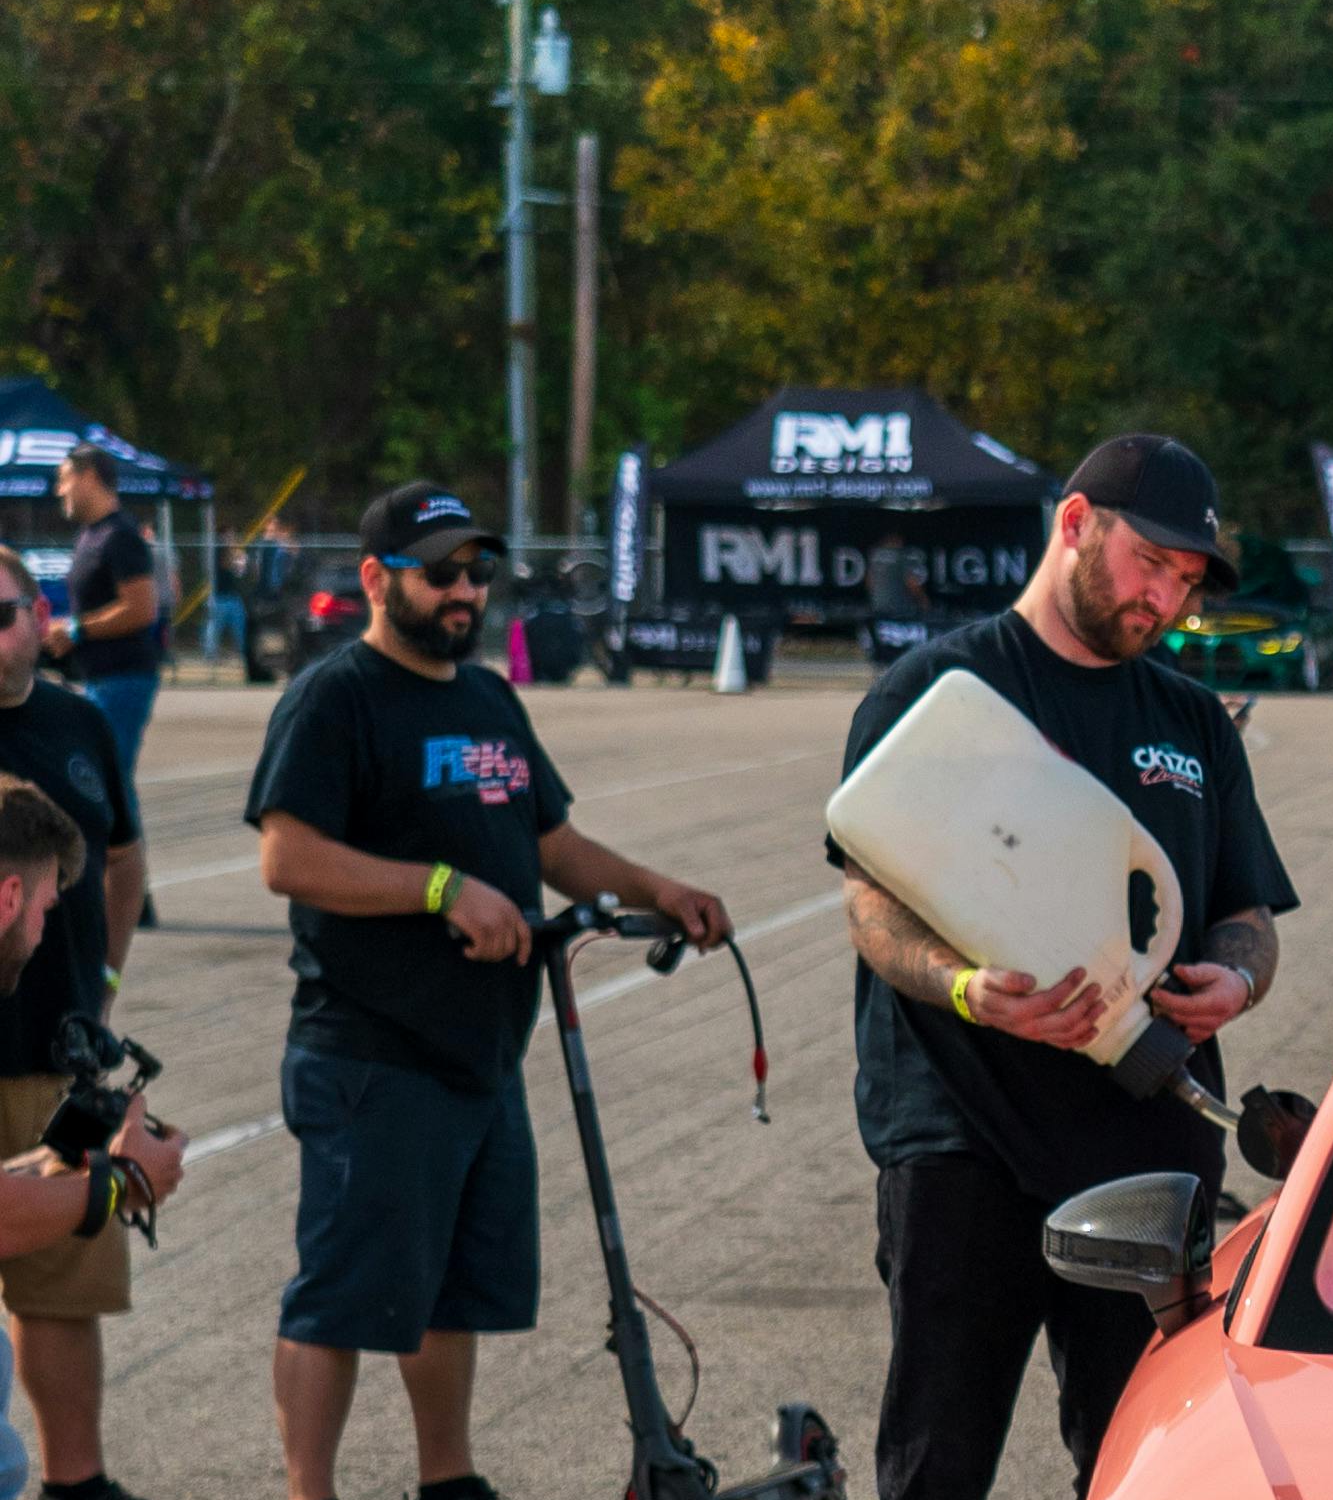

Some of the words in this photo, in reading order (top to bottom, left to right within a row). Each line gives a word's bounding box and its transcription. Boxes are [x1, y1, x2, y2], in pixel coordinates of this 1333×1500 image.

[773, 411, 913, 460] RM1
[772, 456, 914, 474] DESIGN
[701, 523, 824, 586] RM1
[833, 546, 1028, 587] DSIGN
